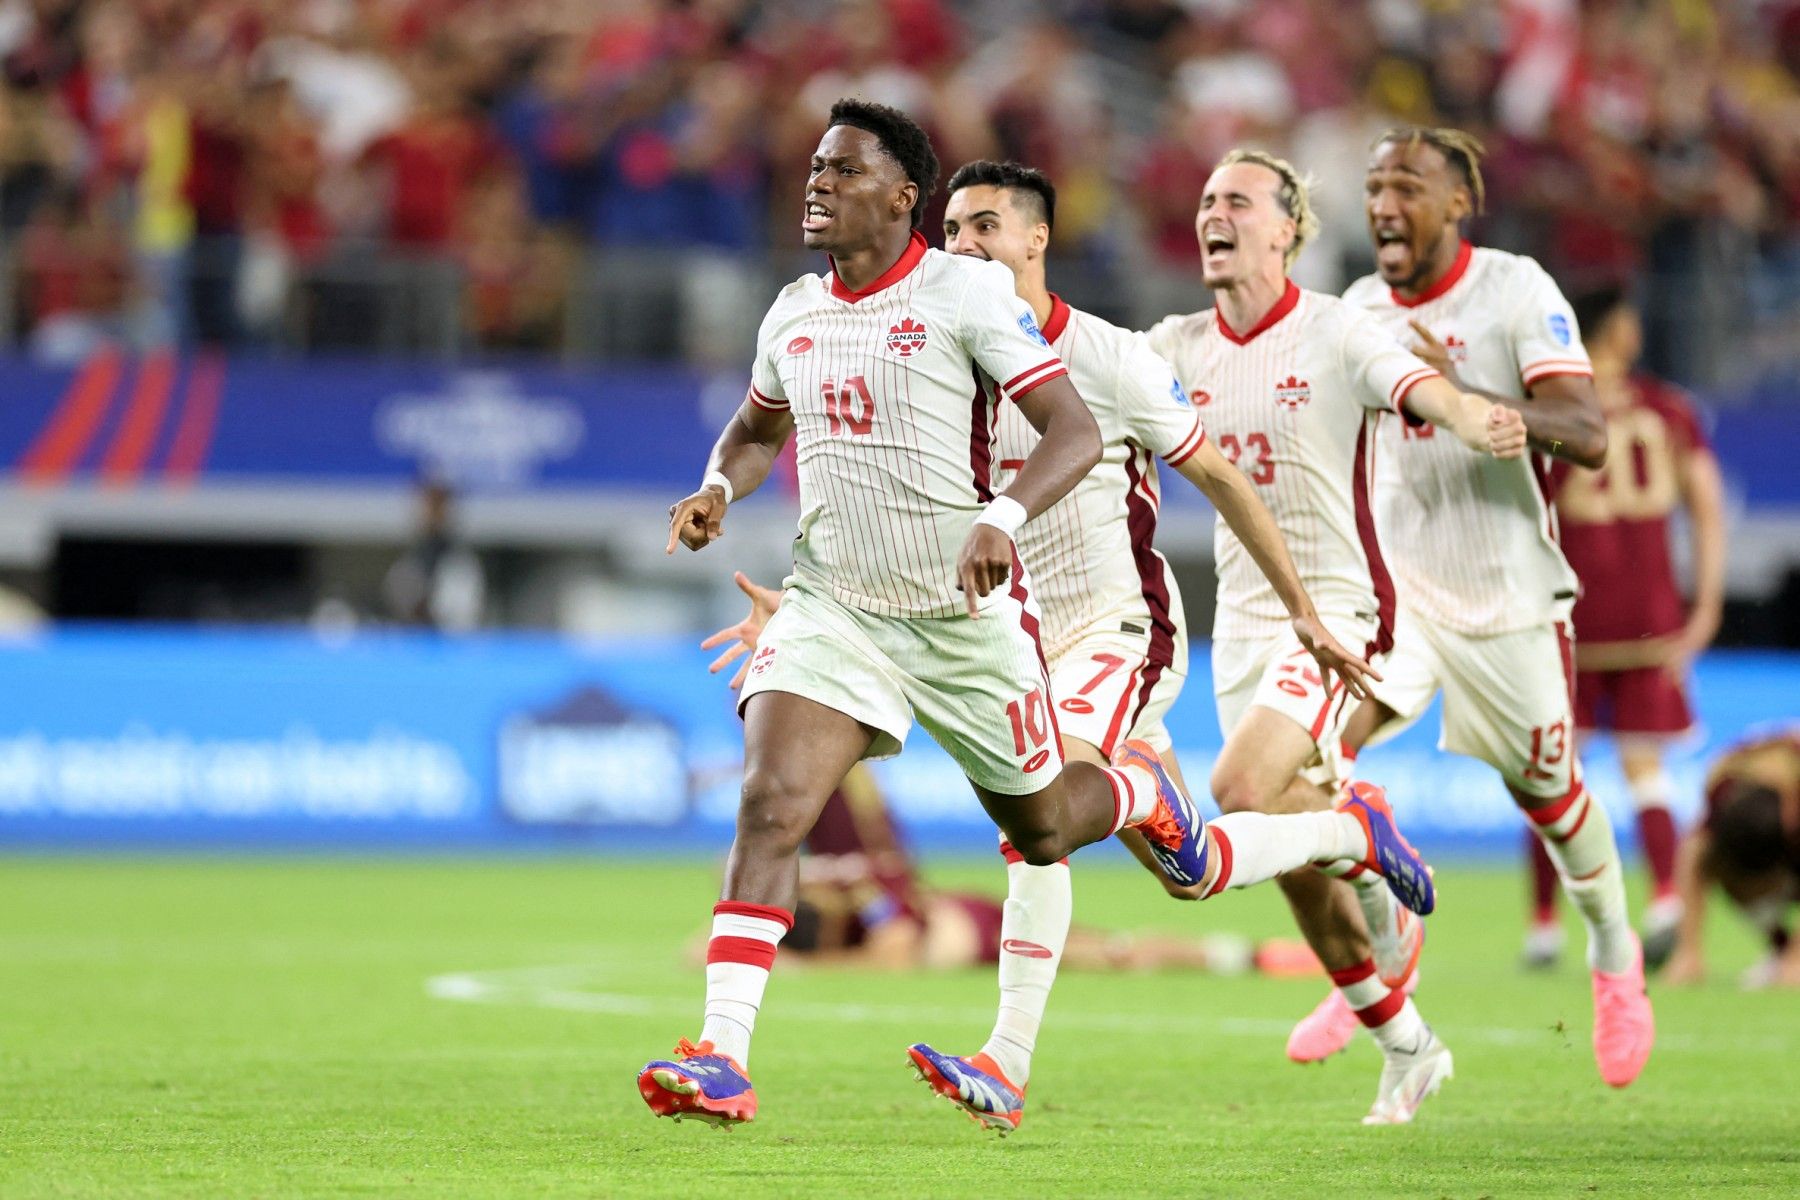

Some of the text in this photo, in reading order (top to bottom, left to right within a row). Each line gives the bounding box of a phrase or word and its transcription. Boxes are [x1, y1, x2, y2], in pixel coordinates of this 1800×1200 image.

[821, 375, 874, 436] 10
[1077, 653, 1126, 695] 7
[1005, 687, 1048, 757] 10
[1530, 721, 1565, 765] 13
